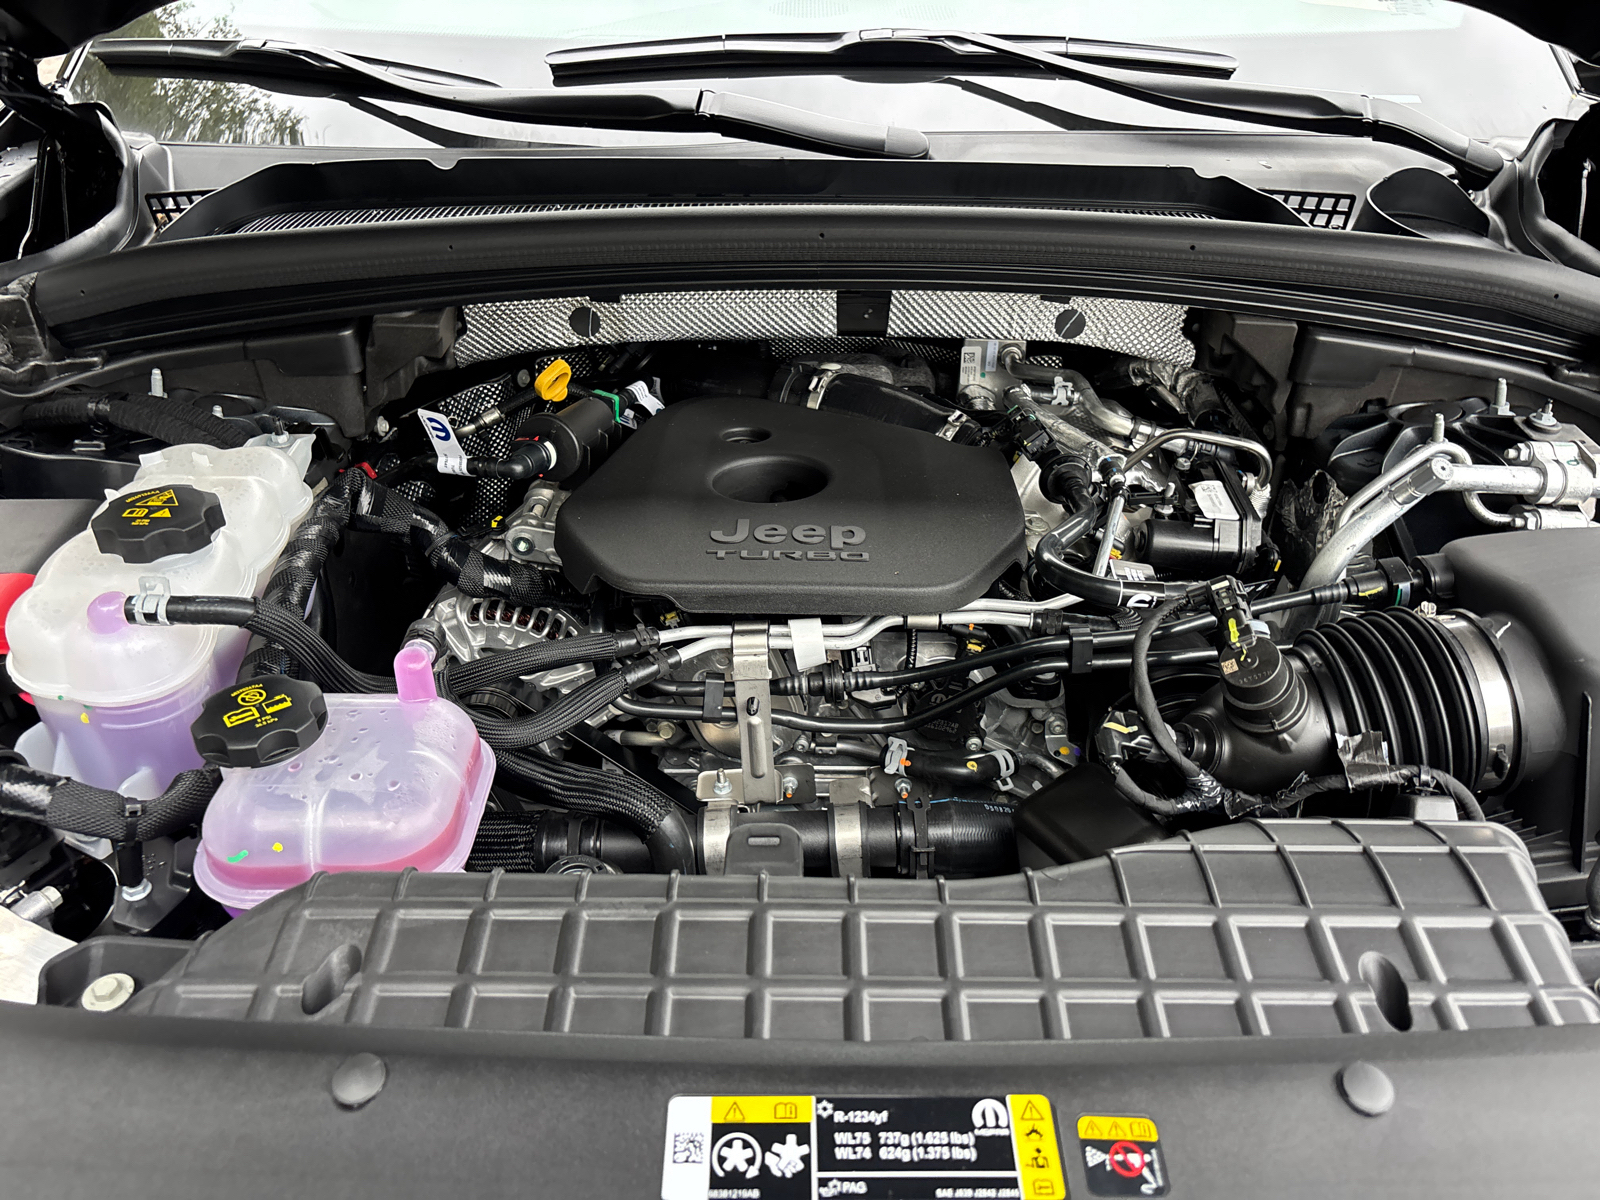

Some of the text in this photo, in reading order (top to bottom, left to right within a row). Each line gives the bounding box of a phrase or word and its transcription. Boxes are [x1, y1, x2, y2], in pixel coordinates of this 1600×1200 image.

[710, 518, 866, 550] Jeep
[706, 550, 870, 562] TURBO
[833, 1110, 889, 1126] R-1234yf
[834, 1131, 976, 1147] WL75 737g (1.625 lbs)
[834, 1146, 977, 1162] WL74 624g (1.375 lbs)
[842, 1181, 868, 1194] PAG
